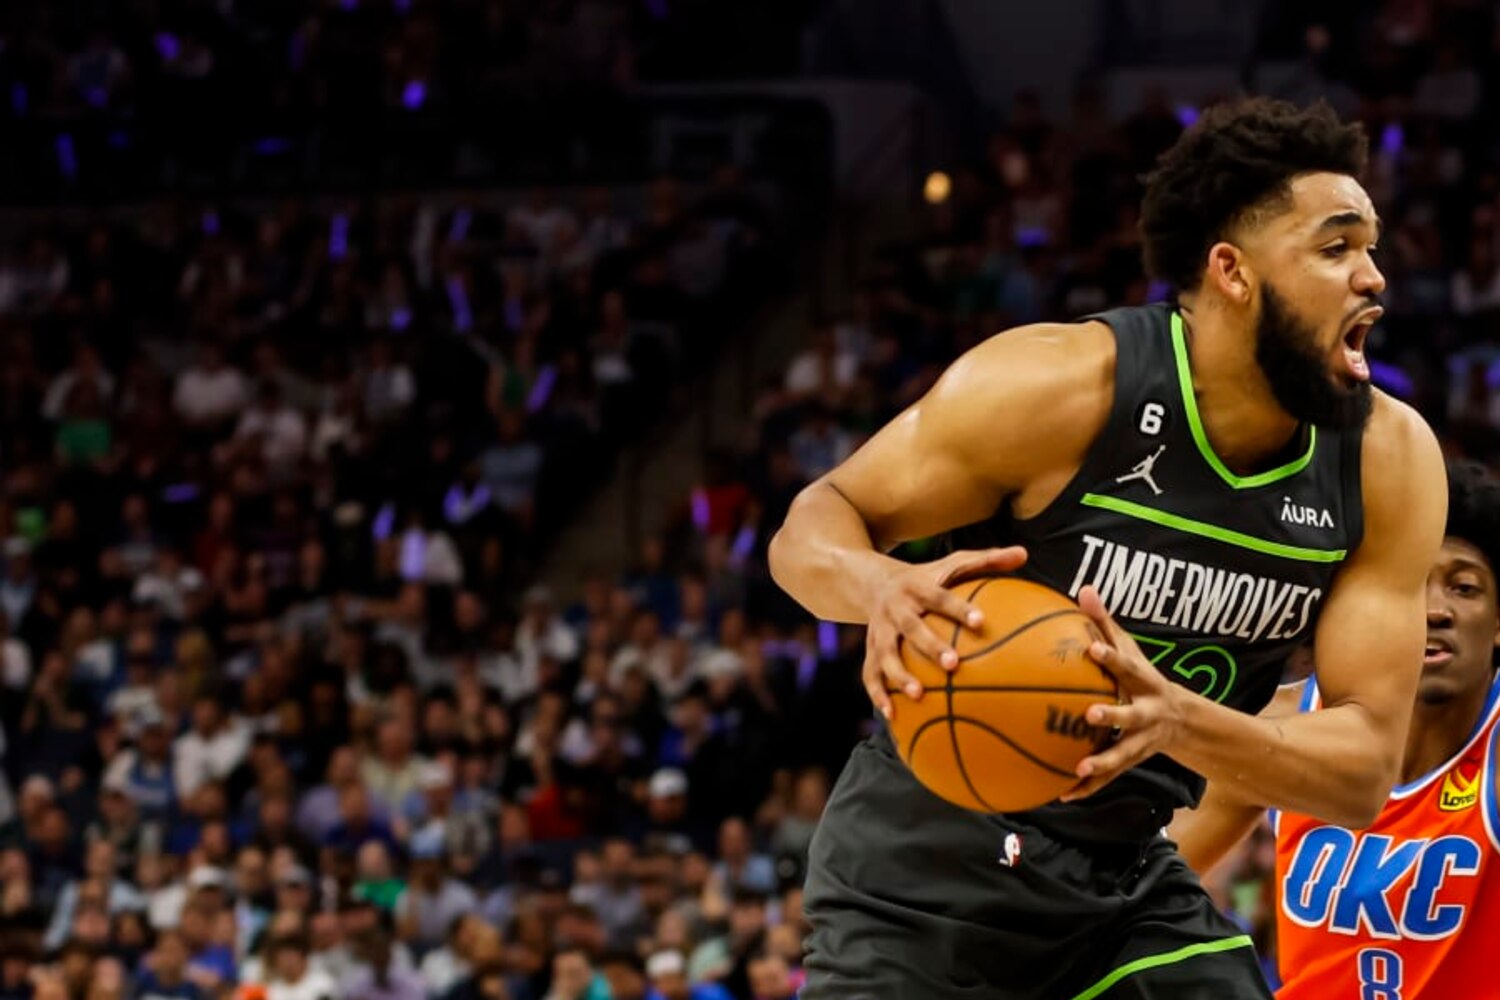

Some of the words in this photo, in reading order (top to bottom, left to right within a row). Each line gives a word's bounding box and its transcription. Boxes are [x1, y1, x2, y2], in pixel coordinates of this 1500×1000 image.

[1139, 402, 1165, 435] 6
[1067, 533, 1322, 643] TIMBERWOLVES
[1281, 825, 1482, 942] OKC
